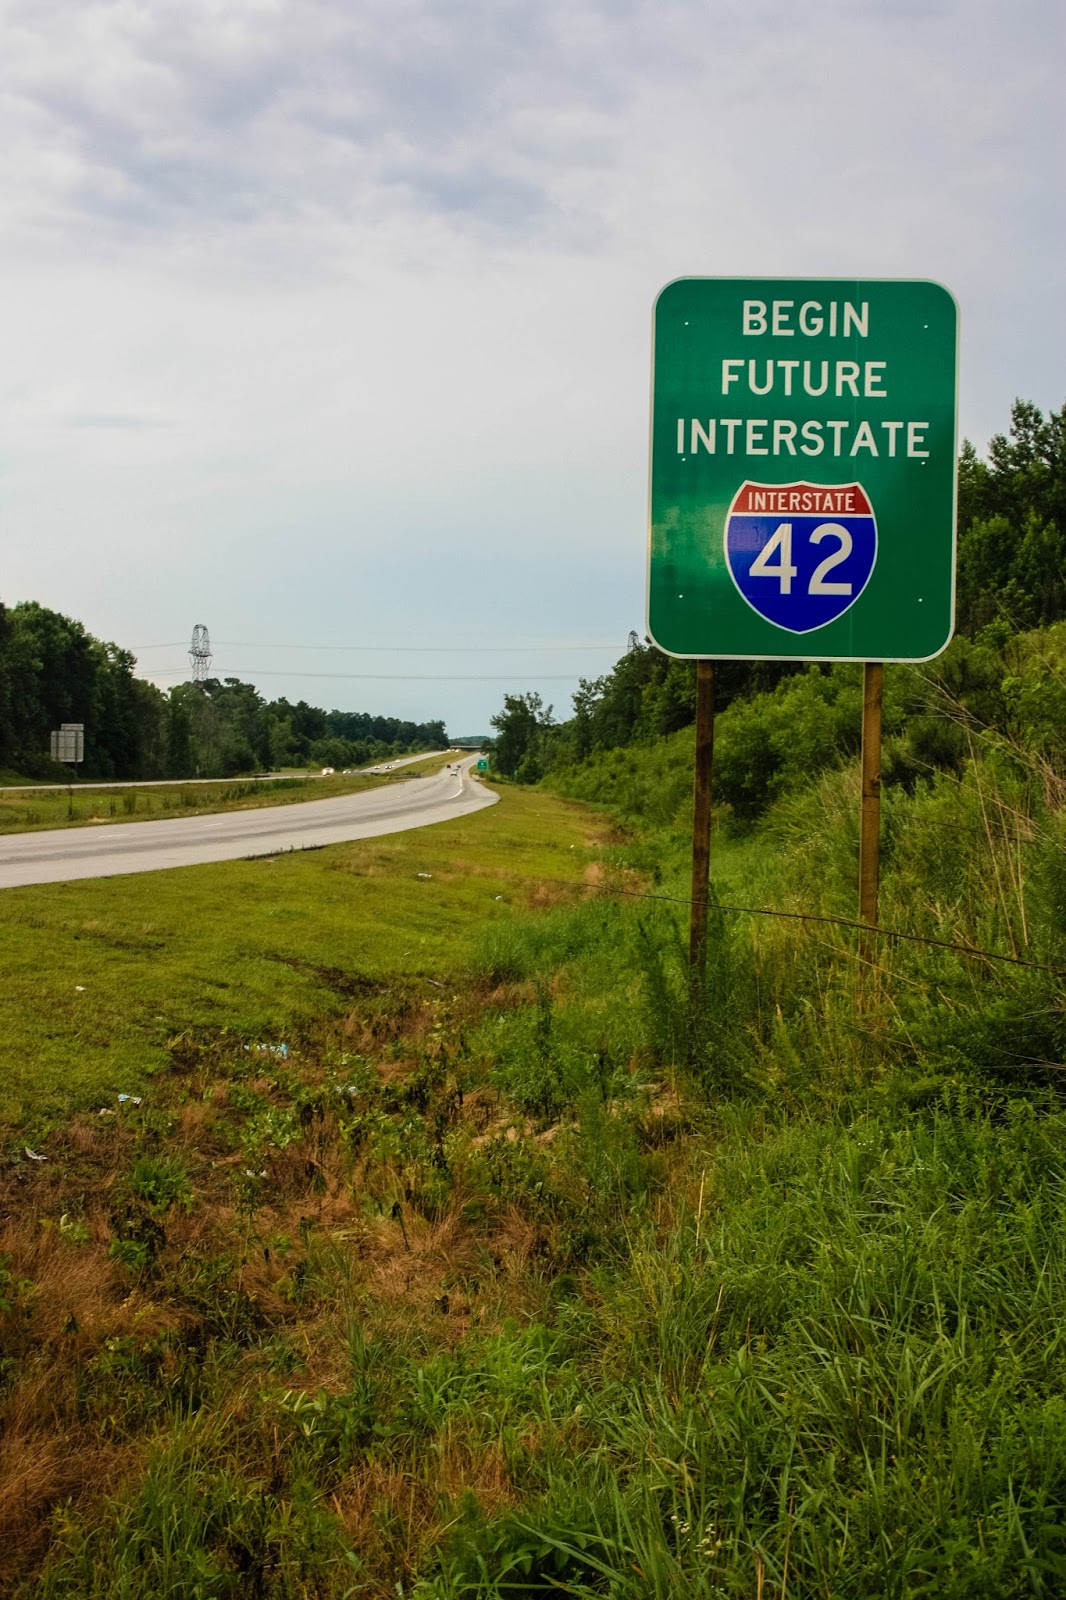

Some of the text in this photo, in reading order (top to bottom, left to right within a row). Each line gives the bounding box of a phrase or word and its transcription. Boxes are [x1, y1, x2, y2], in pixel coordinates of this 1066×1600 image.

[742, 300, 869, 337] BEGIN
[721, 359, 888, 397] FUTURE
[677, 418, 930, 458] INTERSTATE
[748, 492, 855, 511] INTERSTATE
[749, 522, 853, 595] 42
